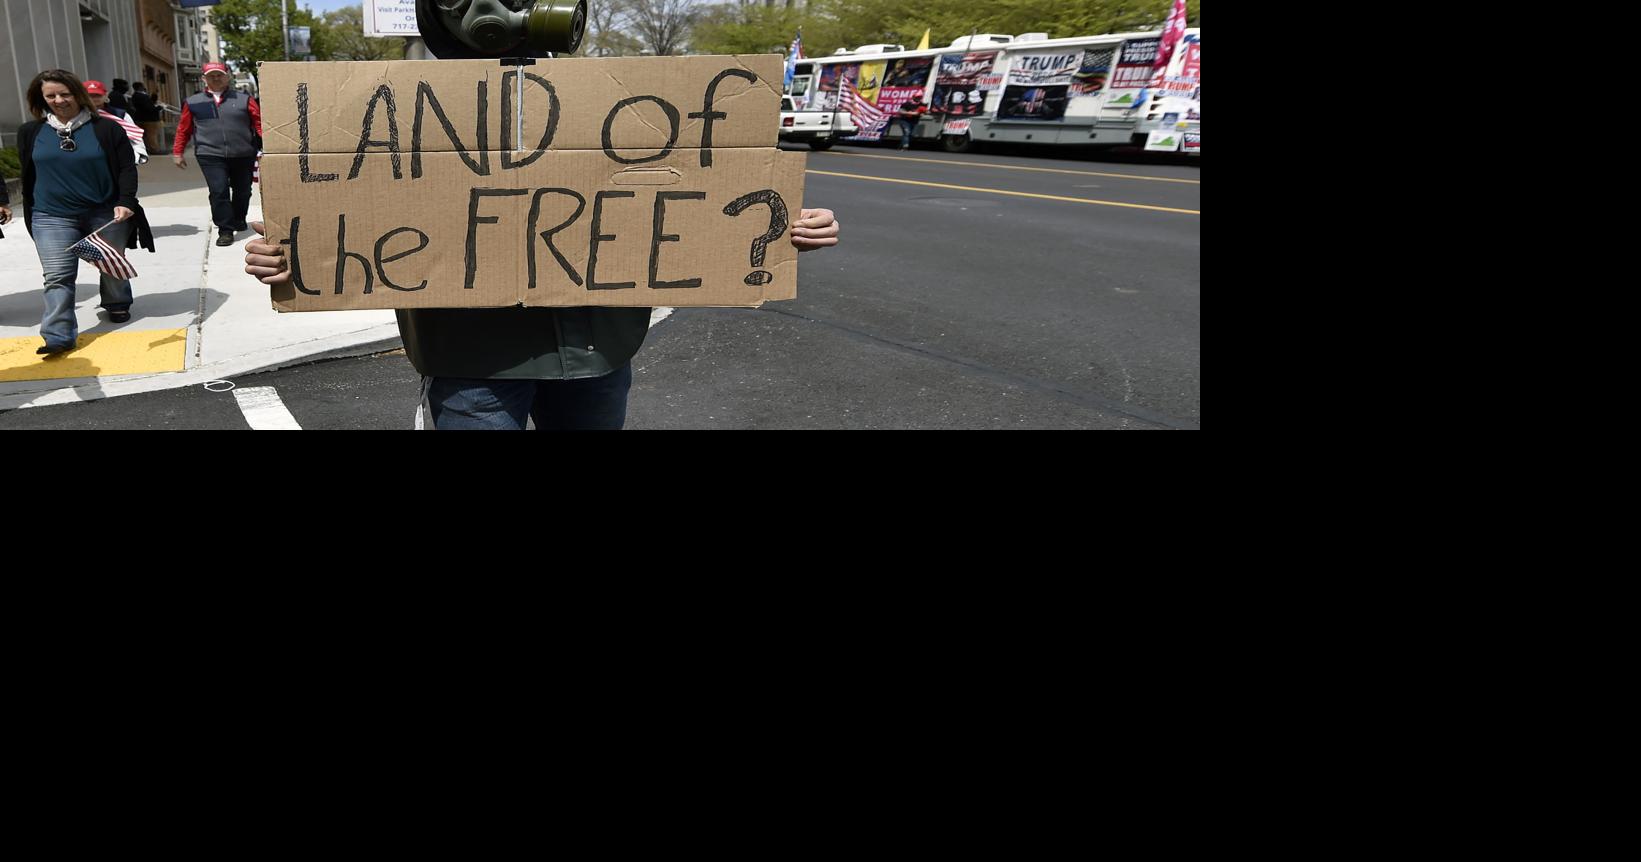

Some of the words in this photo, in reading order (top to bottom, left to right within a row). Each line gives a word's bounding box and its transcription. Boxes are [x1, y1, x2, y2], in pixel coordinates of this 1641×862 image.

[1022, 54, 1076, 71] TRUMP
[1123, 53, 1154, 62] TRU
[1115, 66, 1154, 81] TRUM
[878, 103, 901, 113] TRU
[296, 71, 560, 183] LAND
[602, 68, 758, 168] of
[280, 213, 430, 296] the
